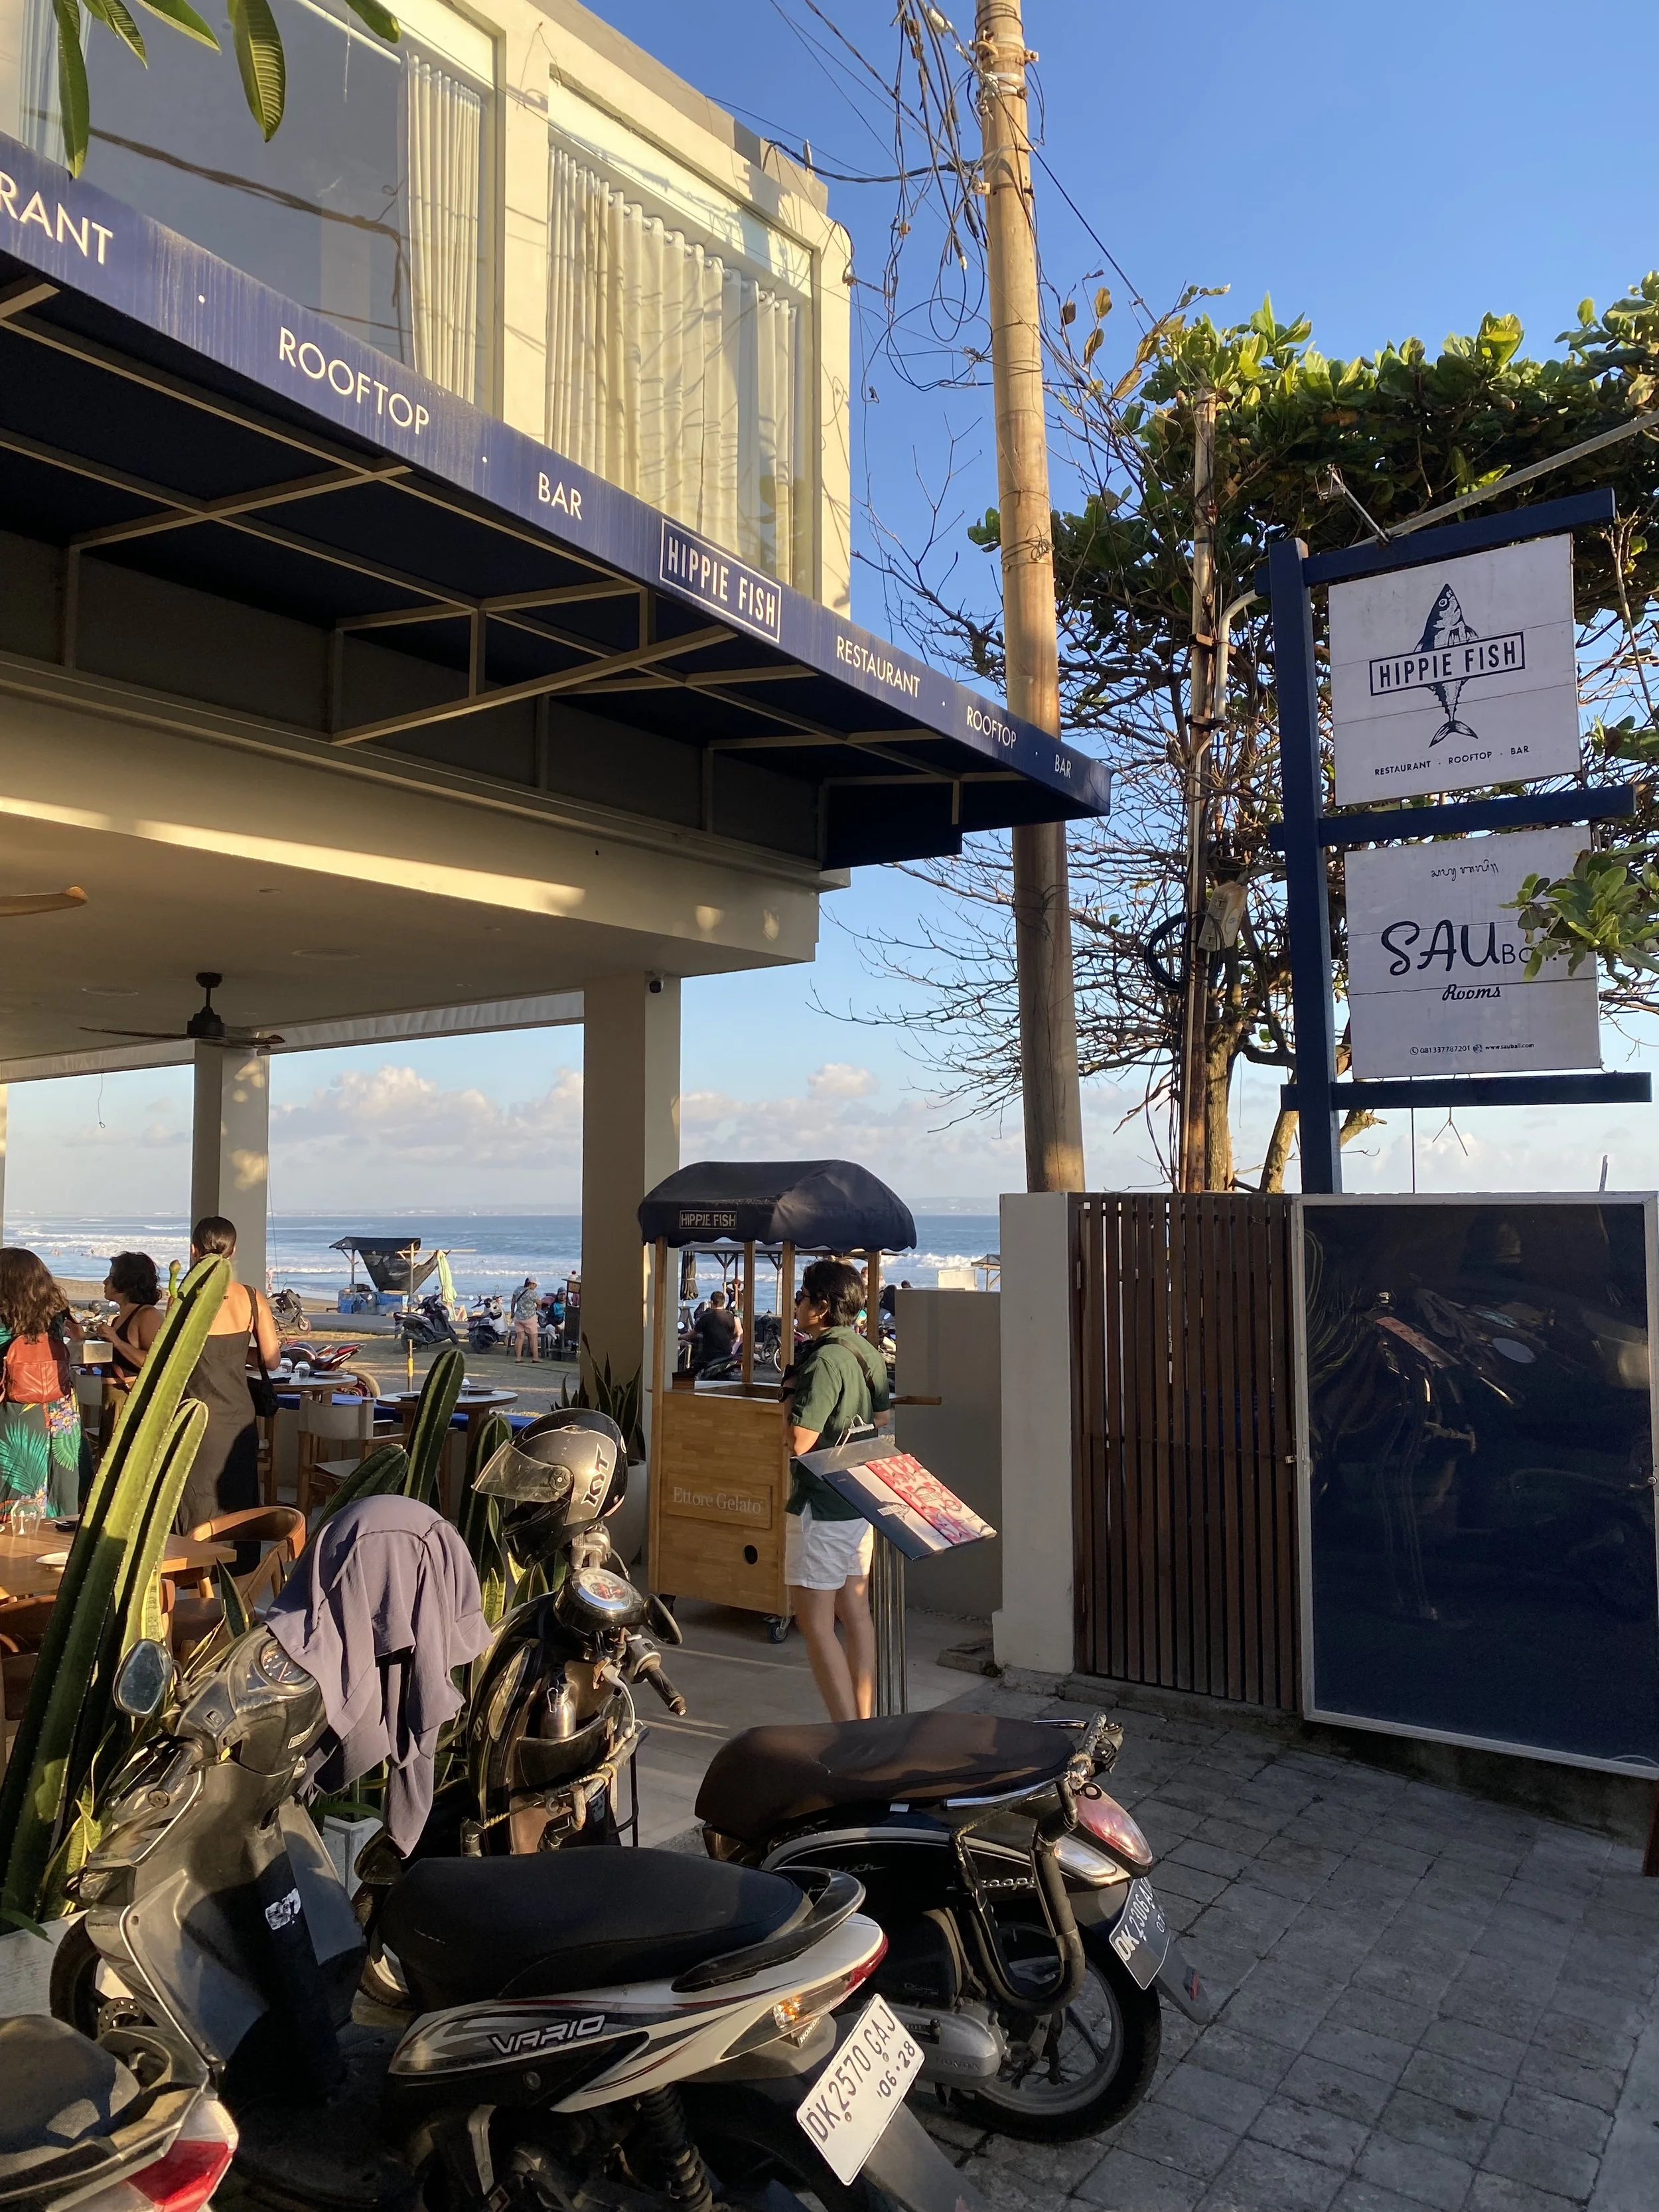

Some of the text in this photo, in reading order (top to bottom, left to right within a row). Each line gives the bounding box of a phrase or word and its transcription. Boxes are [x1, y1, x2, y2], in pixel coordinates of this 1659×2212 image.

[279, 326, 429, 435] ROOFTOP
[538, 471, 583, 520] BAR
[667, 536, 776, 628] HIPPIE FISH
[1380, 640, 1516, 688] HIPPIE FISH
[836, 634, 1072, 779] RESTAURANT ROOFTOP BAR
[1374, 745, 1530, 776] RESTAURANT ROOFTOP BAR
[1441, 984, 1501, 1001] Rooms
[681, 1213, 736, 1227] HIPPIE FISH
[673, 1487, 762, 1514] Ettore Gelato
[1114, 1923, 1140, 1962] DK
[492, 2014, 605, 2055] VARIO
[806, 2095, 841, 2143] DK
[828, 2045, 871, 2112] 2570
